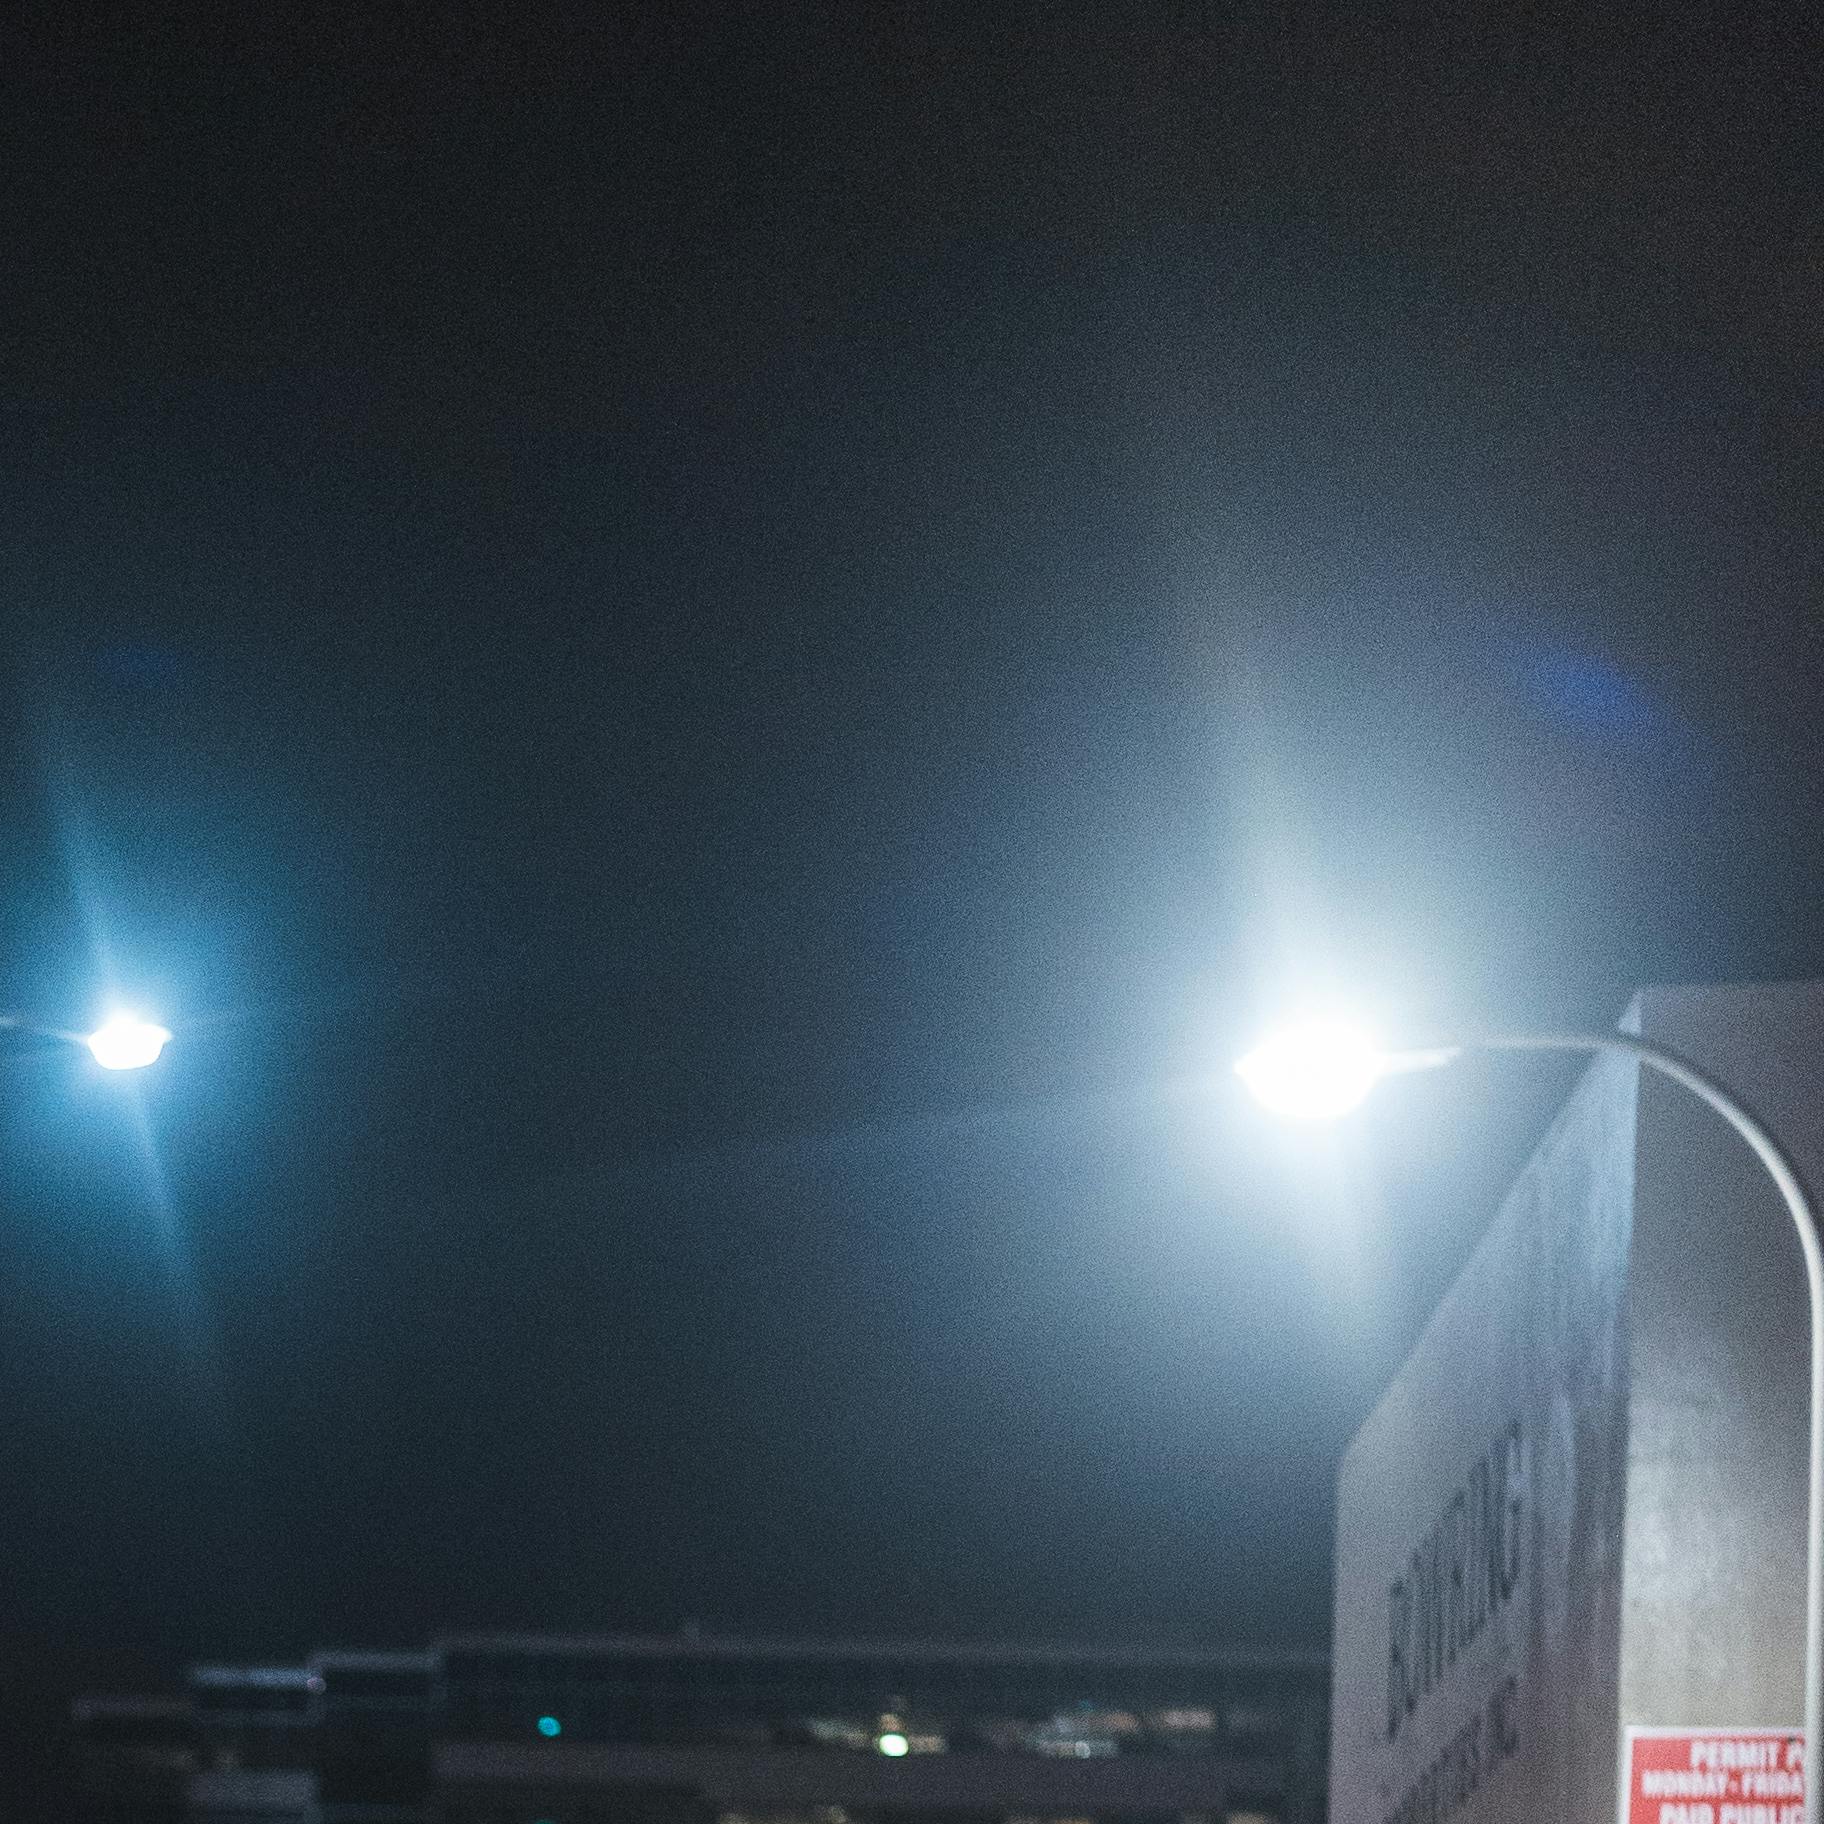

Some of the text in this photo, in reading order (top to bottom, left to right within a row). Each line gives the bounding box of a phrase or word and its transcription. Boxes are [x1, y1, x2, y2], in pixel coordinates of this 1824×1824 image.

[1690, 1741, 1780, 1768] PERMIT
[1642, 1769, 1728, 1797] MONDAY
[1741, 1770, 1804, 1797] FRIDA
